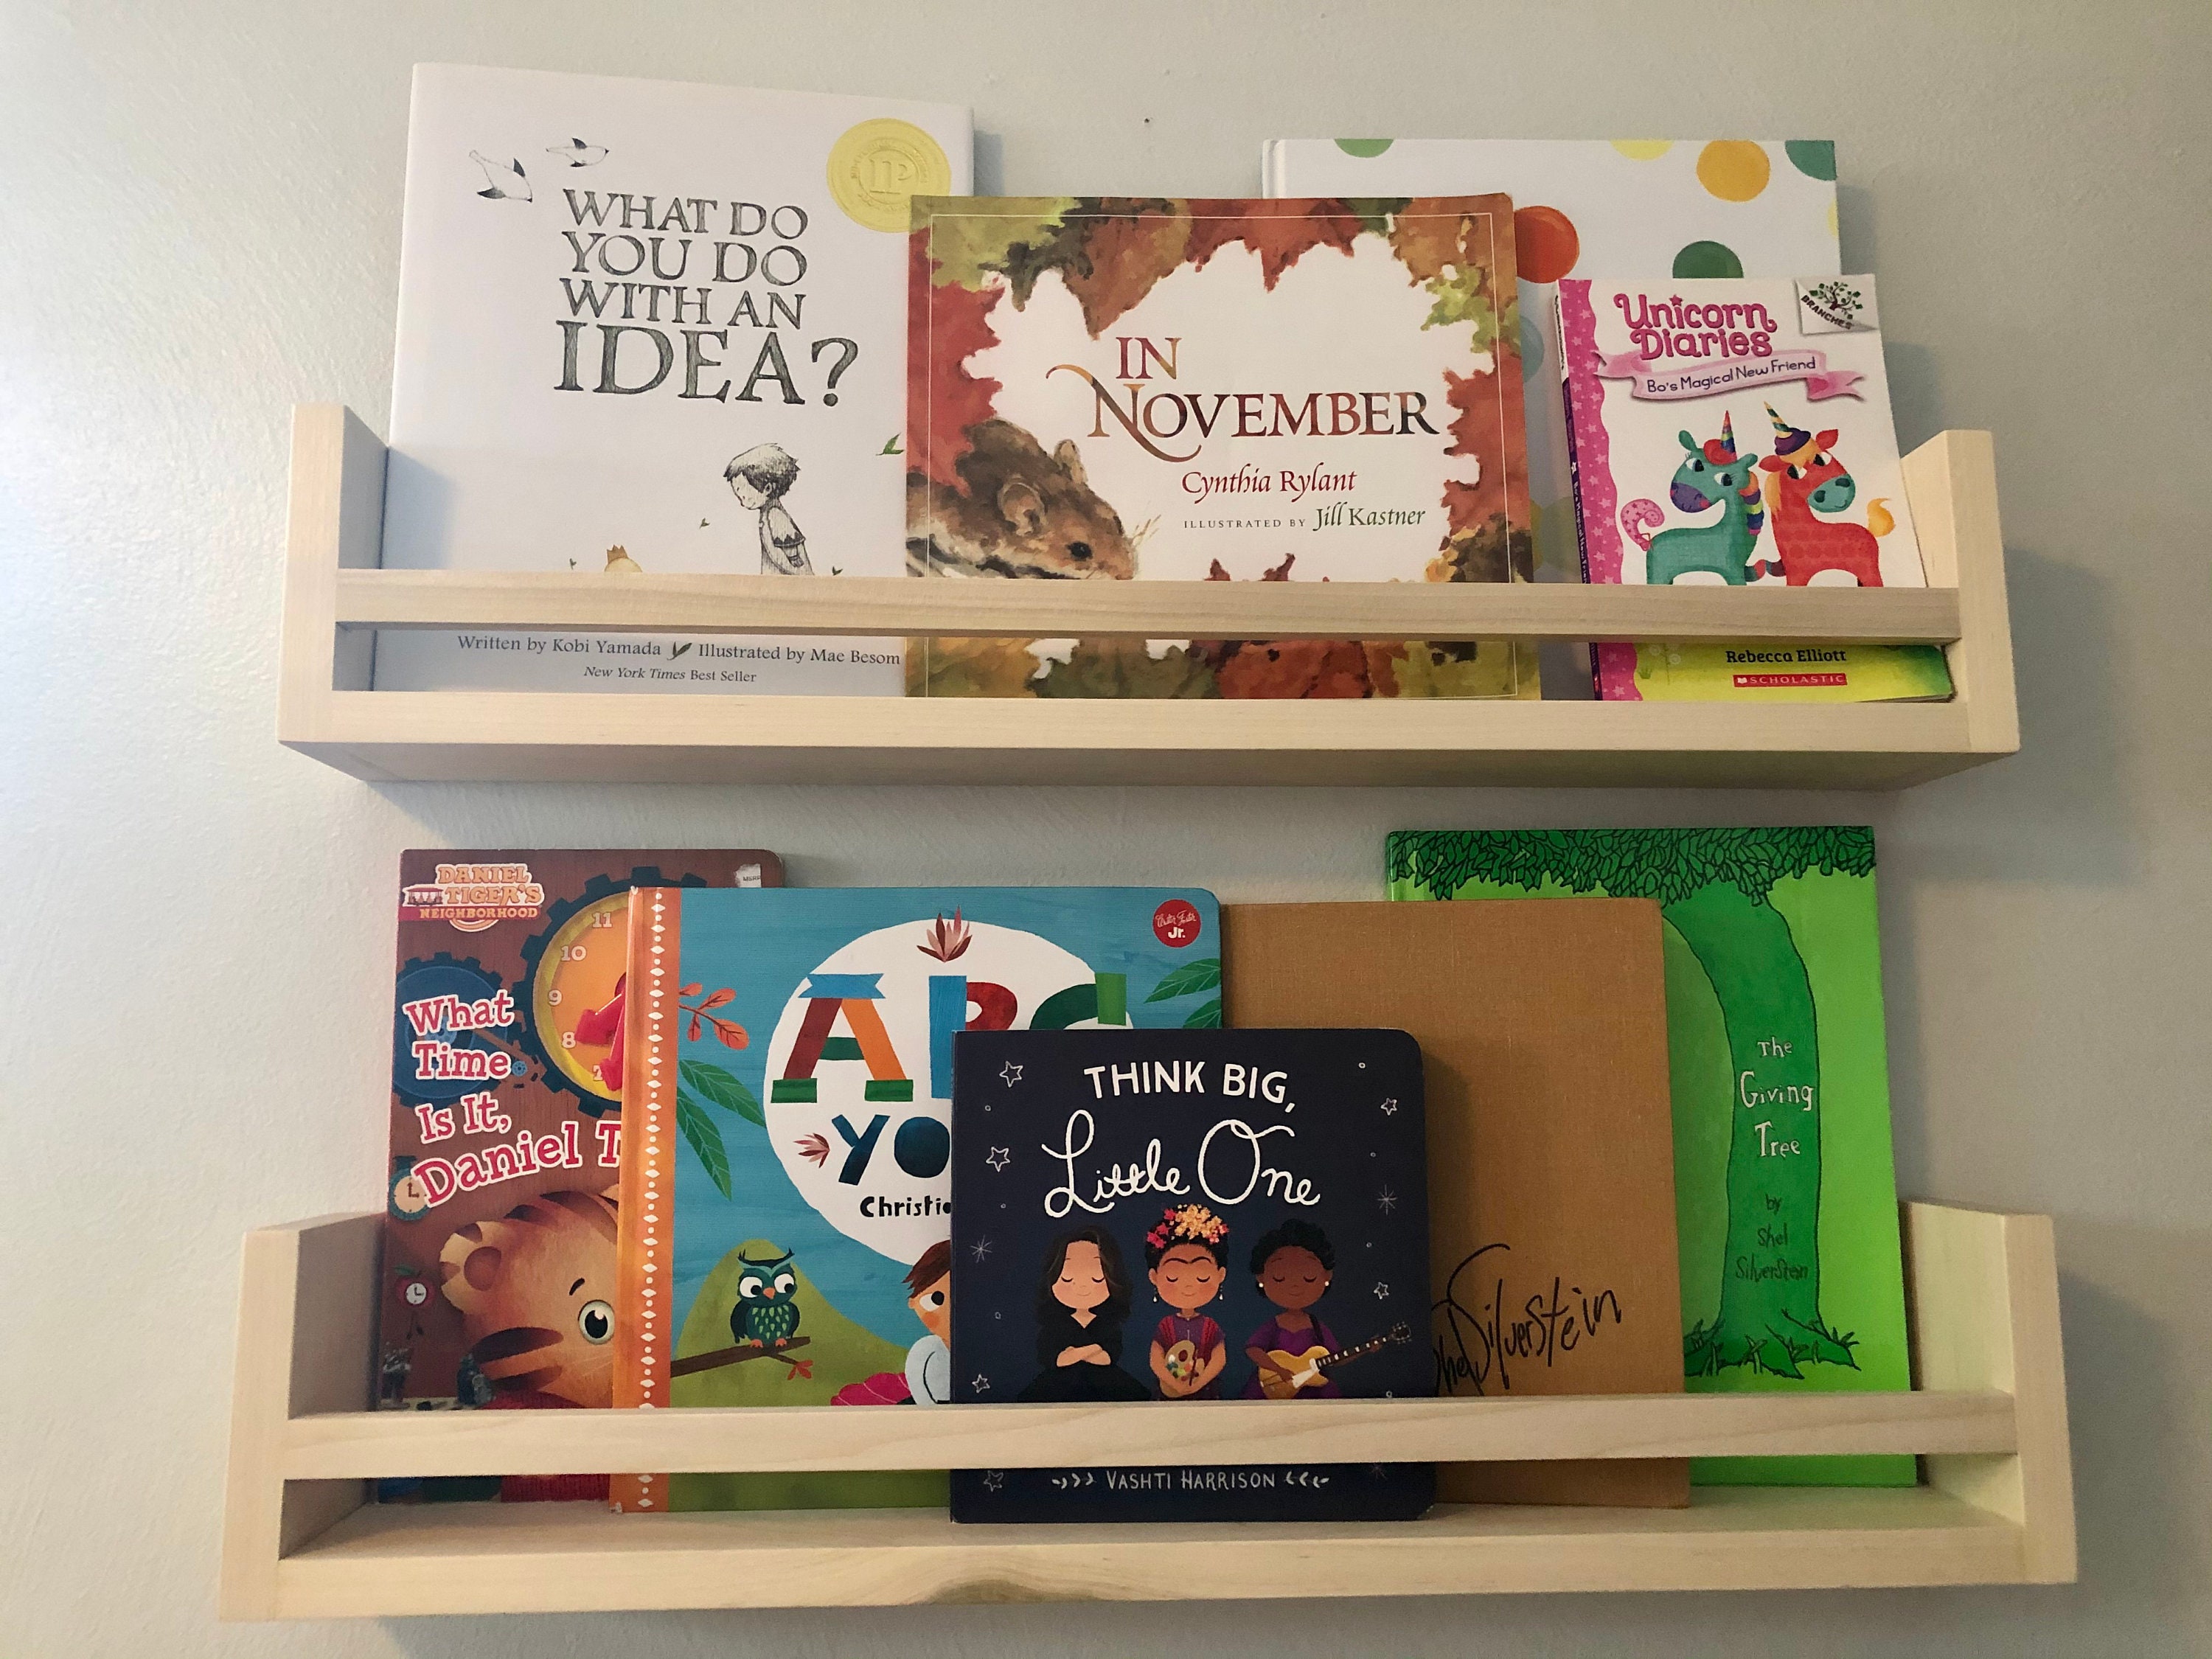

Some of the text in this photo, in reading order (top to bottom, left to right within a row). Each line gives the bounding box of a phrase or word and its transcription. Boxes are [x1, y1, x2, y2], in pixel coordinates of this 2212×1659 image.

[562, 189, 808, 239] WHAT DO
[561, 231, 807, 286] YOU DO
[559, 278, 806, 330] WITH AN
[1613, 293, 1777, 333] Unicorn
[1801, 295, 1853, 330] BRANCHES
[1116, 337, 1182, 380] IN
[1630, 328, 1773, 360] Diaries
[553, 320, 858, 407] IDEA?
[1646, 357, 1816, 394] Bo's Magical New Friend
[1182, 462, 1357, 504] Cynthia Rylant
[1184, 501, 1426, 531] ILLUSTRATED BY Jill Kastner
[457, 636, 900, 665] Written by Kobi Yamada Illustrated by Mae Besom
[1725, 649, 1846, 662] Rebecca Elliott
[583, 667, 757, 682] New York Times Best Seller
[1749, 675, 1844, 684] SCHOLASTIC
[438, 866, 529, 883] DANIEL
[445, 884, 542, 905] TIGER'S
[420, 907, 538, 919] NEIGHBORHOOD
[592, 912, 612, 928] 11
[1167, 926, 1186, 939] Jr.
[560, 945, 587, 961] 10
[404, 990, 513, 1034] What
[548, 990, 563, 1006] 9
[561, 1032, 576, 1048] 8
[1757, 1036, 1793, 1058] The
[414, 1042, 511, 1079] Time
[1083, 1060, 1295, 1113] THINK BIG,
[1740, 1071, 1816, 1112] Giving
[417, 1093, 510, 1143] Is It,
[832, 1114, 950, 1186] YO
[1754, 1121, 1801, 1158] Tree
[413, 1121, 581, 1207] Daniel
[1041, 1109, 1321, 1218] Little One
[860, 1195, 951, 1217] Christi
[1765, 1193, 1782, 1215] by
[1757, 1222, 1788, 1248] Shel
[1106, 1470, 1276, 1491] VASHTI HARRISON
